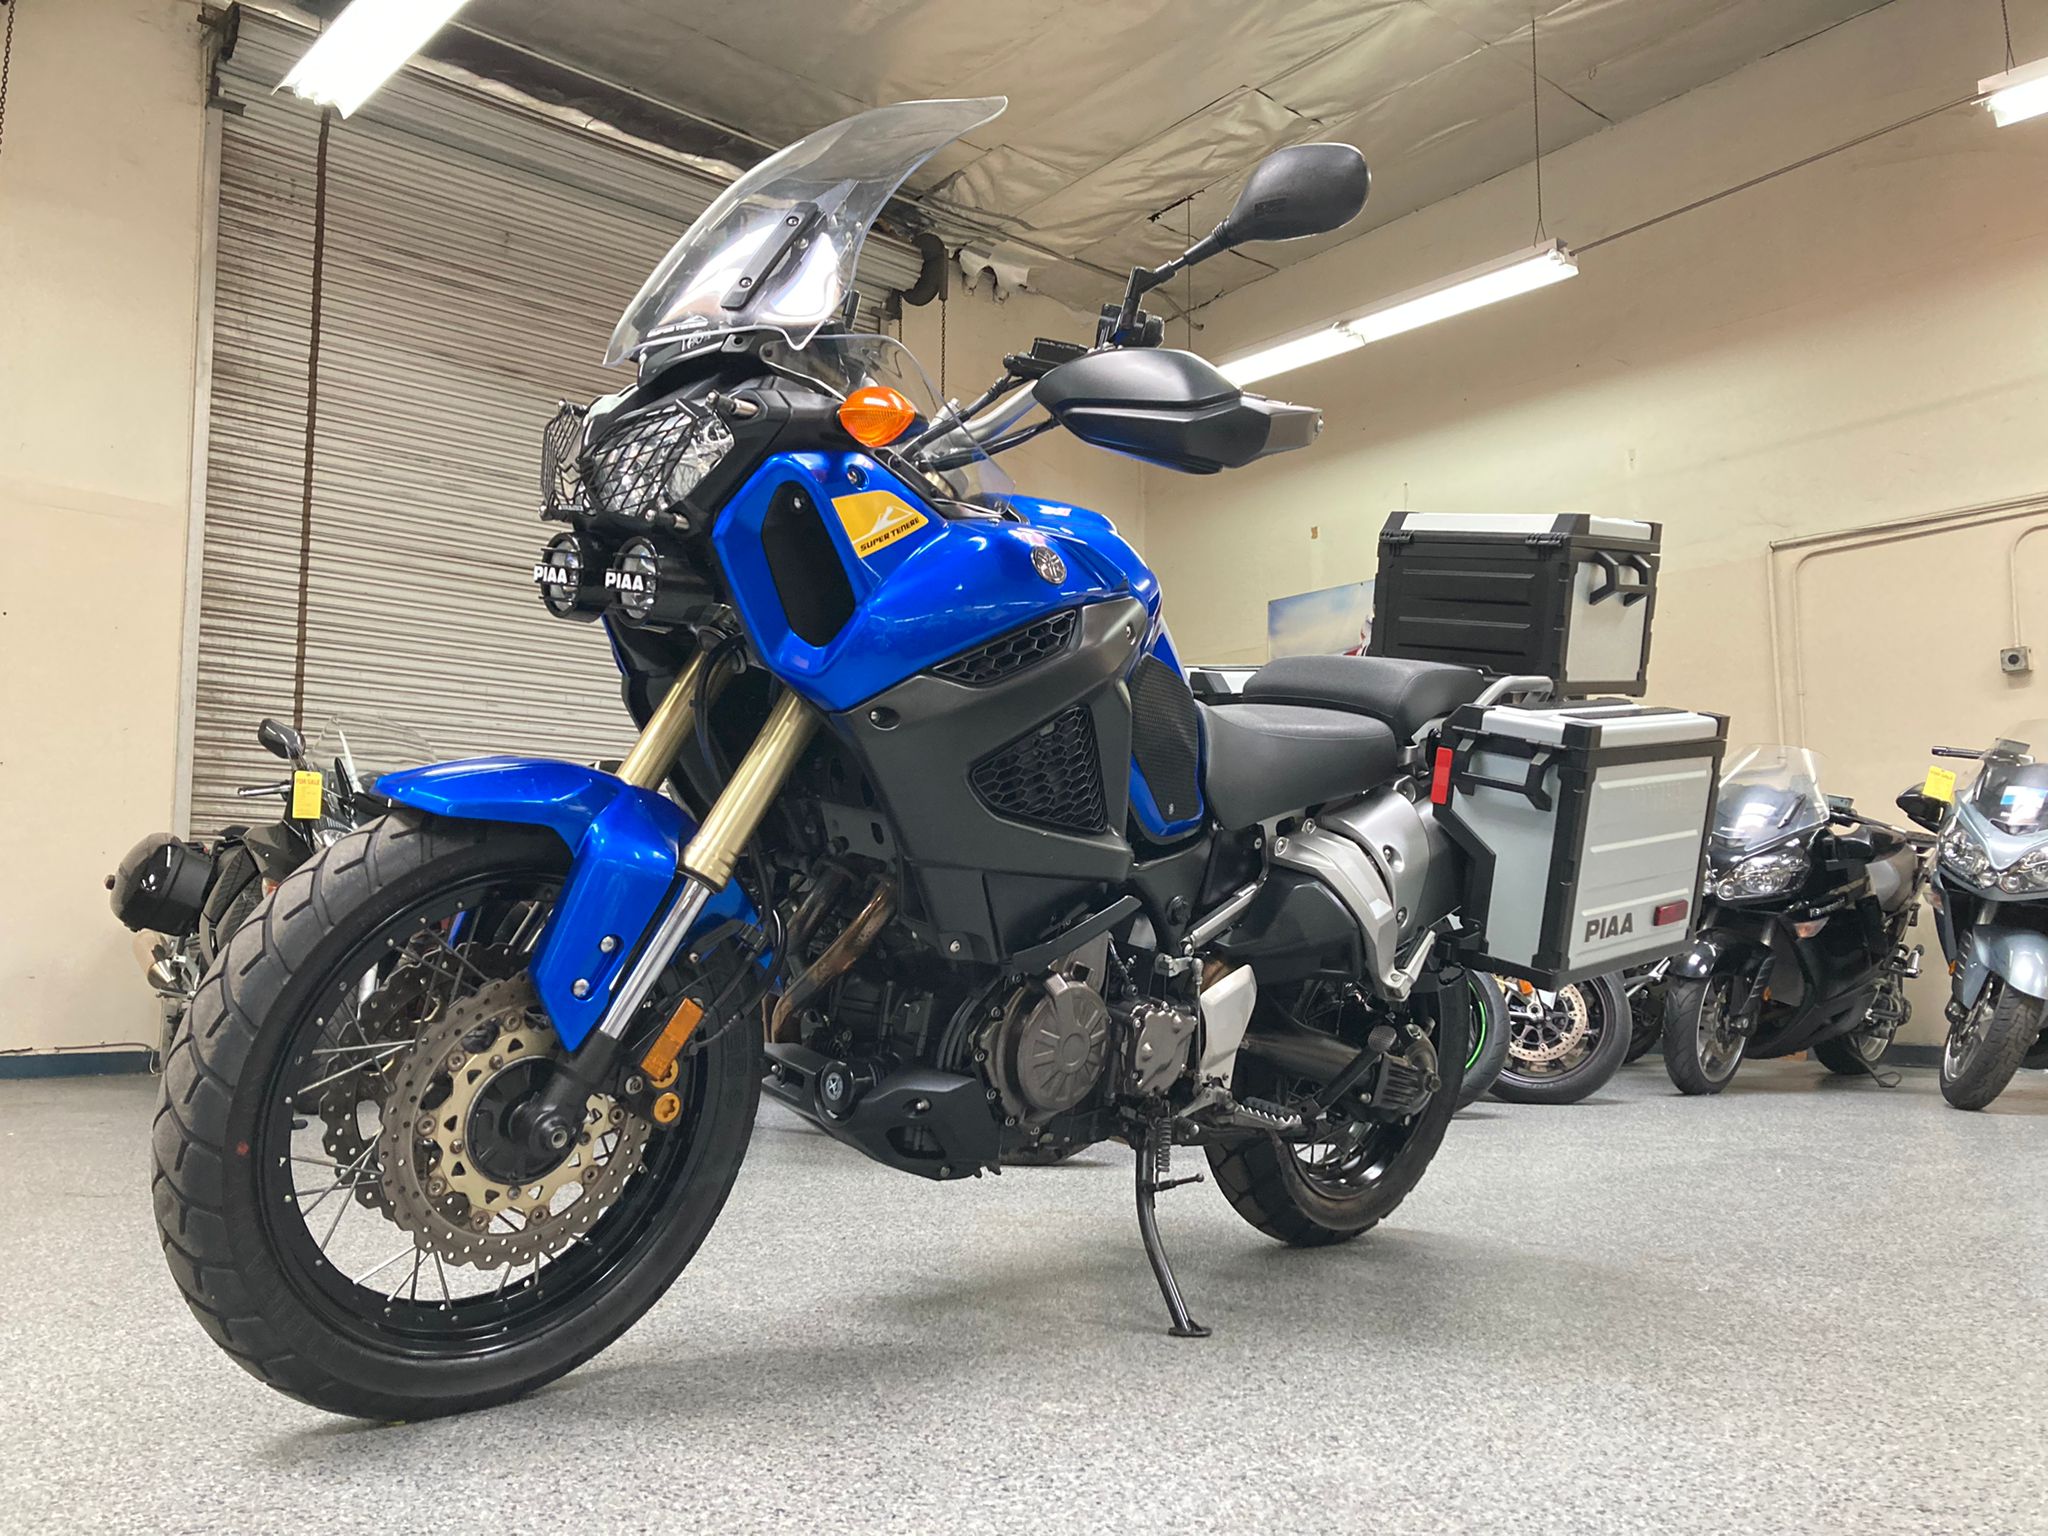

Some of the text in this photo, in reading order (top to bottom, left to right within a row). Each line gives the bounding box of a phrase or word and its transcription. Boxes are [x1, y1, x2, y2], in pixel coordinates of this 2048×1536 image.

[860, 516, 920, 552] SUPER TENERE
[533, 565, 567, 584] PIAA
[605, 571, 644, 591] PIAA
[1584, 912, 1633, 942] PIAA
